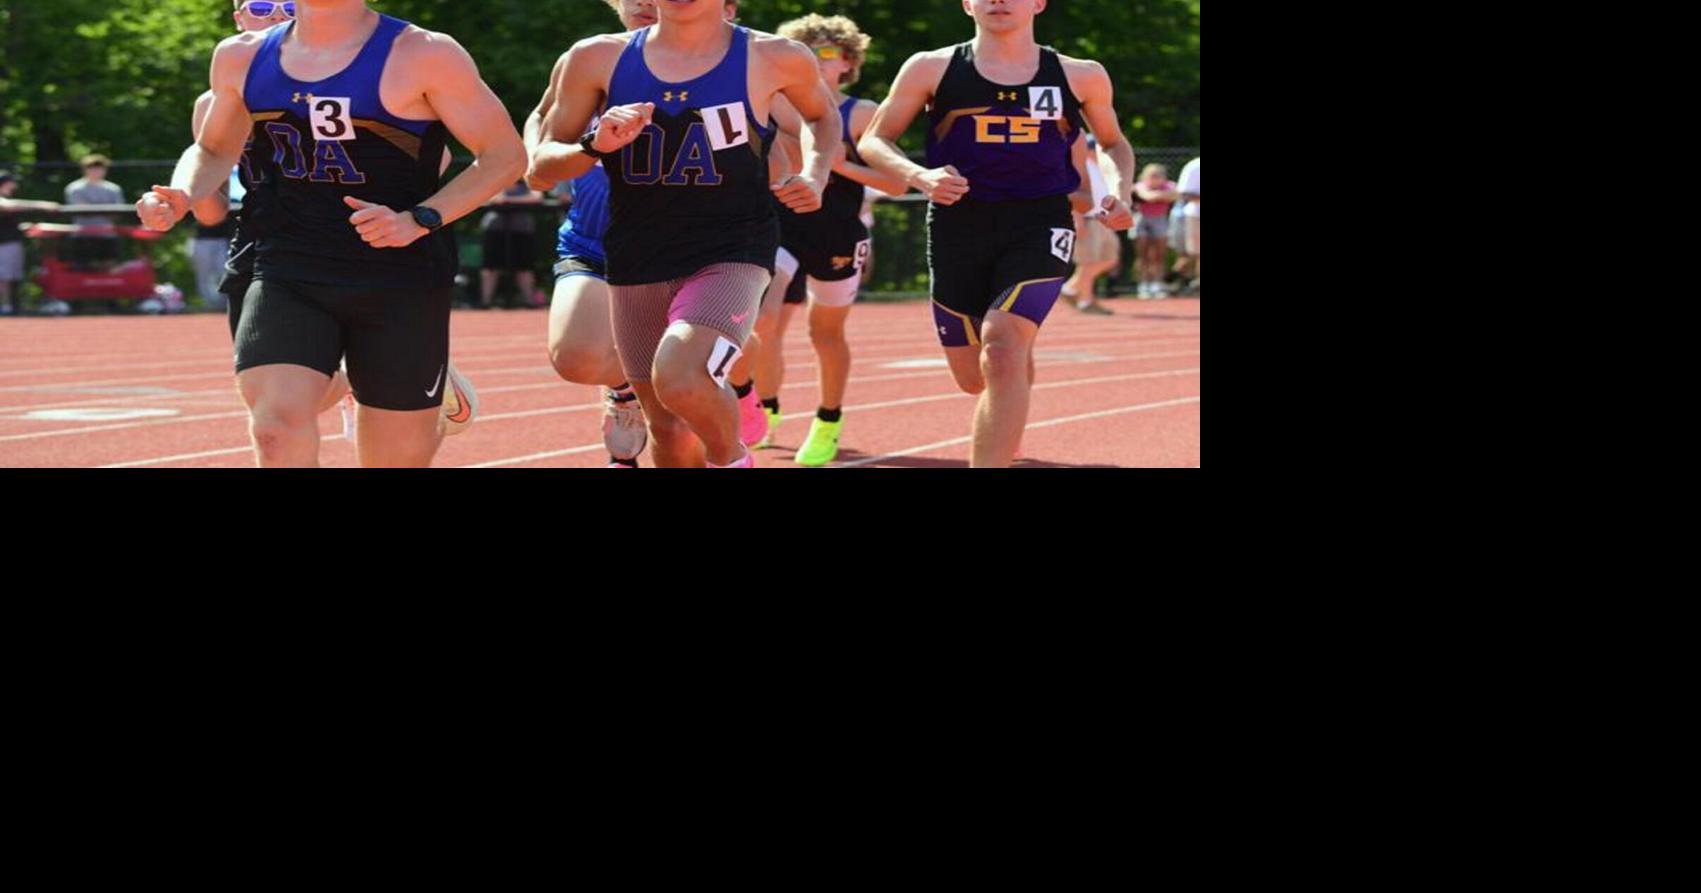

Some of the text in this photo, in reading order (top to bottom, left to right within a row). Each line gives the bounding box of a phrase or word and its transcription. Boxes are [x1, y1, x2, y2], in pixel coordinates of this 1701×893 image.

[314, 99, 347, 138] 3
[1034, 88, 1058, 117] 4
[717, 107, 742, 145] 1
[972, 115, 1042, 143] CS
[620, 121, 724, 186] OA
[1054, 230, 1070, 259] 4
[712, 344, 738, 378] 1
